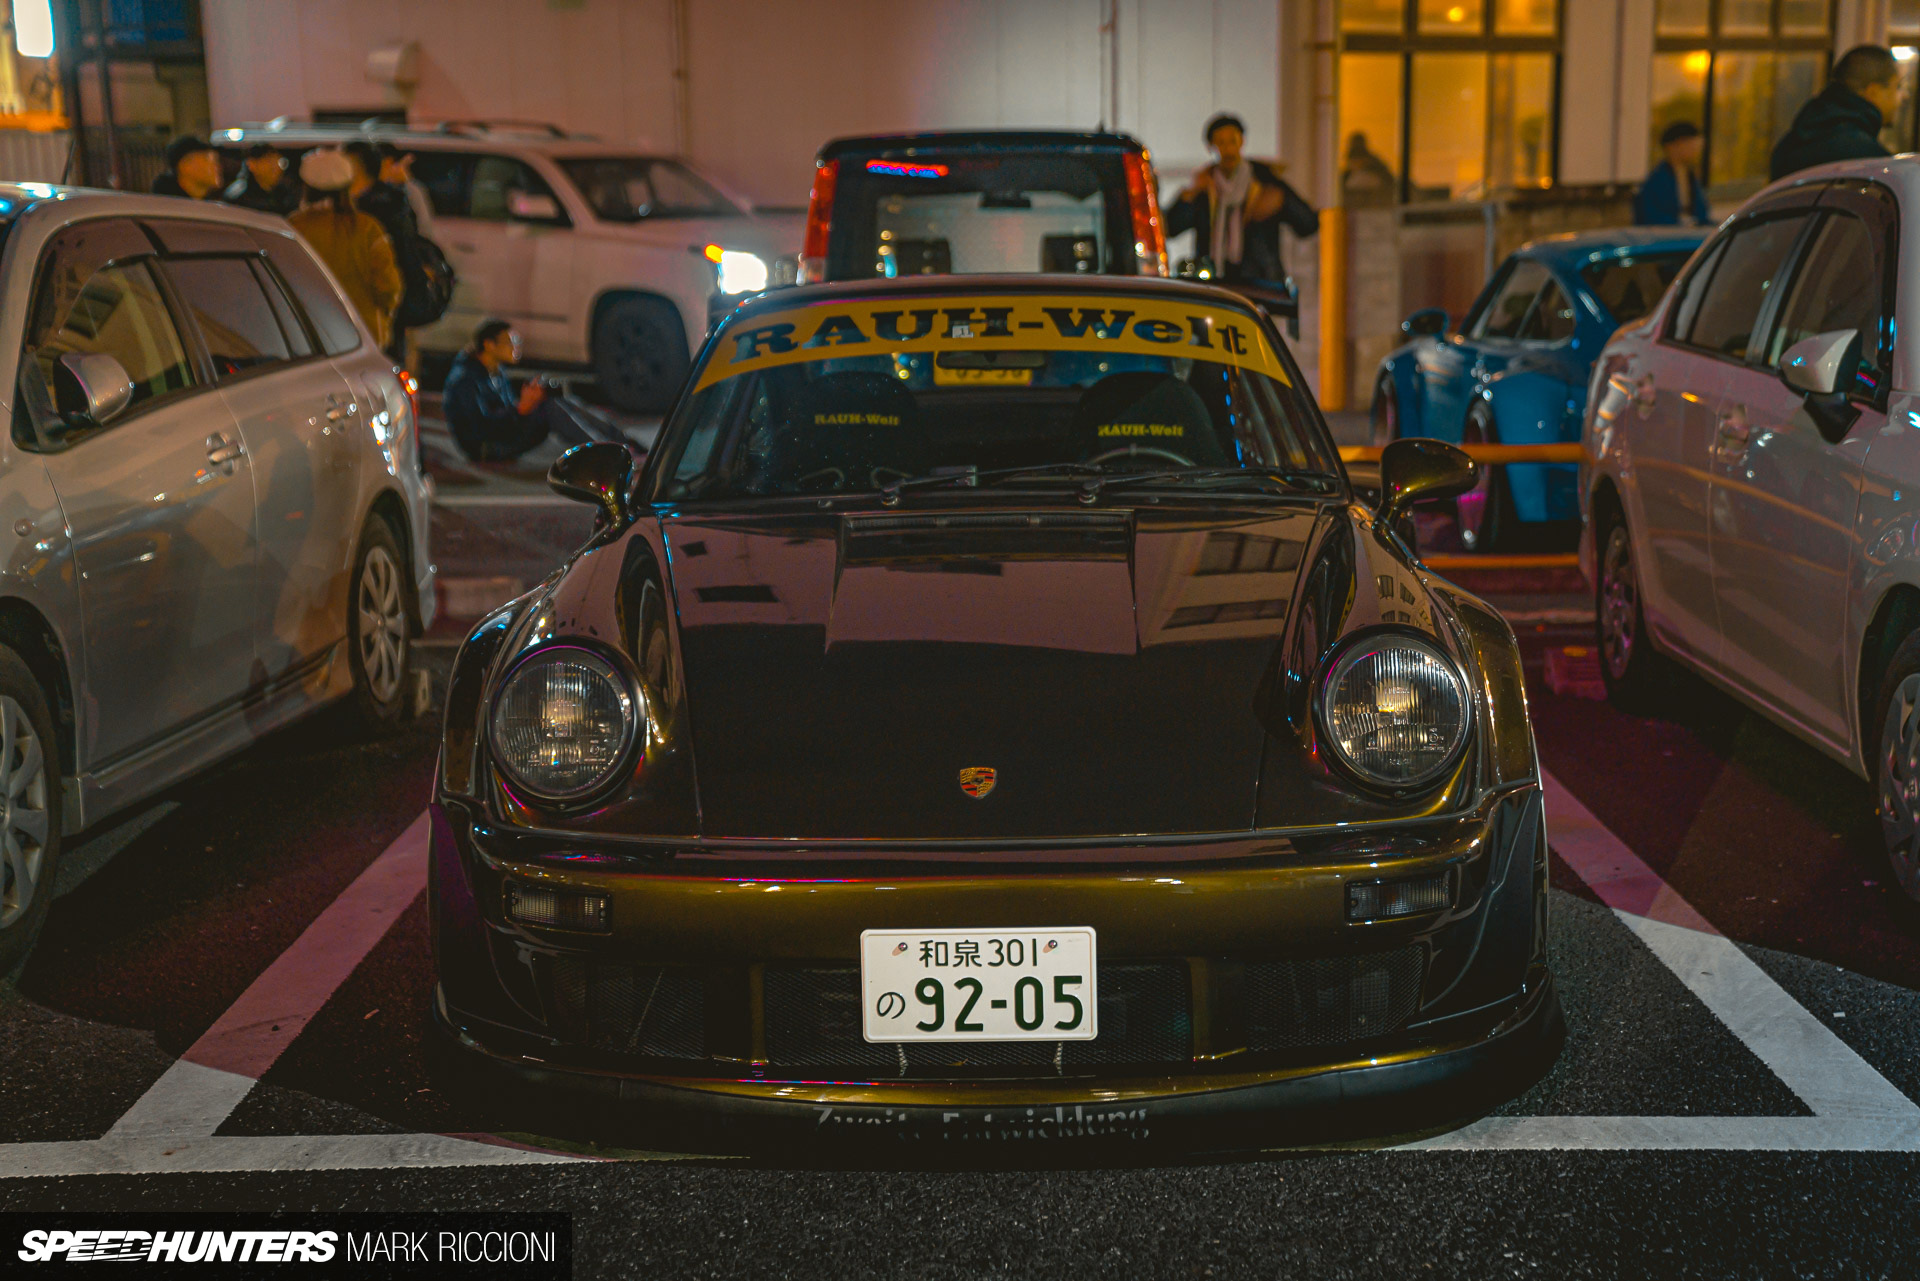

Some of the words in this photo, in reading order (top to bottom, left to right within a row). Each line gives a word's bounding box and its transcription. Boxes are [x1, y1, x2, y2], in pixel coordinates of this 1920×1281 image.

[731, 306, 1248, 363] RAUH-Welt
[814, 413, 900, 426] RAUH-Welt
[1097, 423, 1184, 437] RAUH-Welt
[914, 975, 1084, 1032] 92-05
